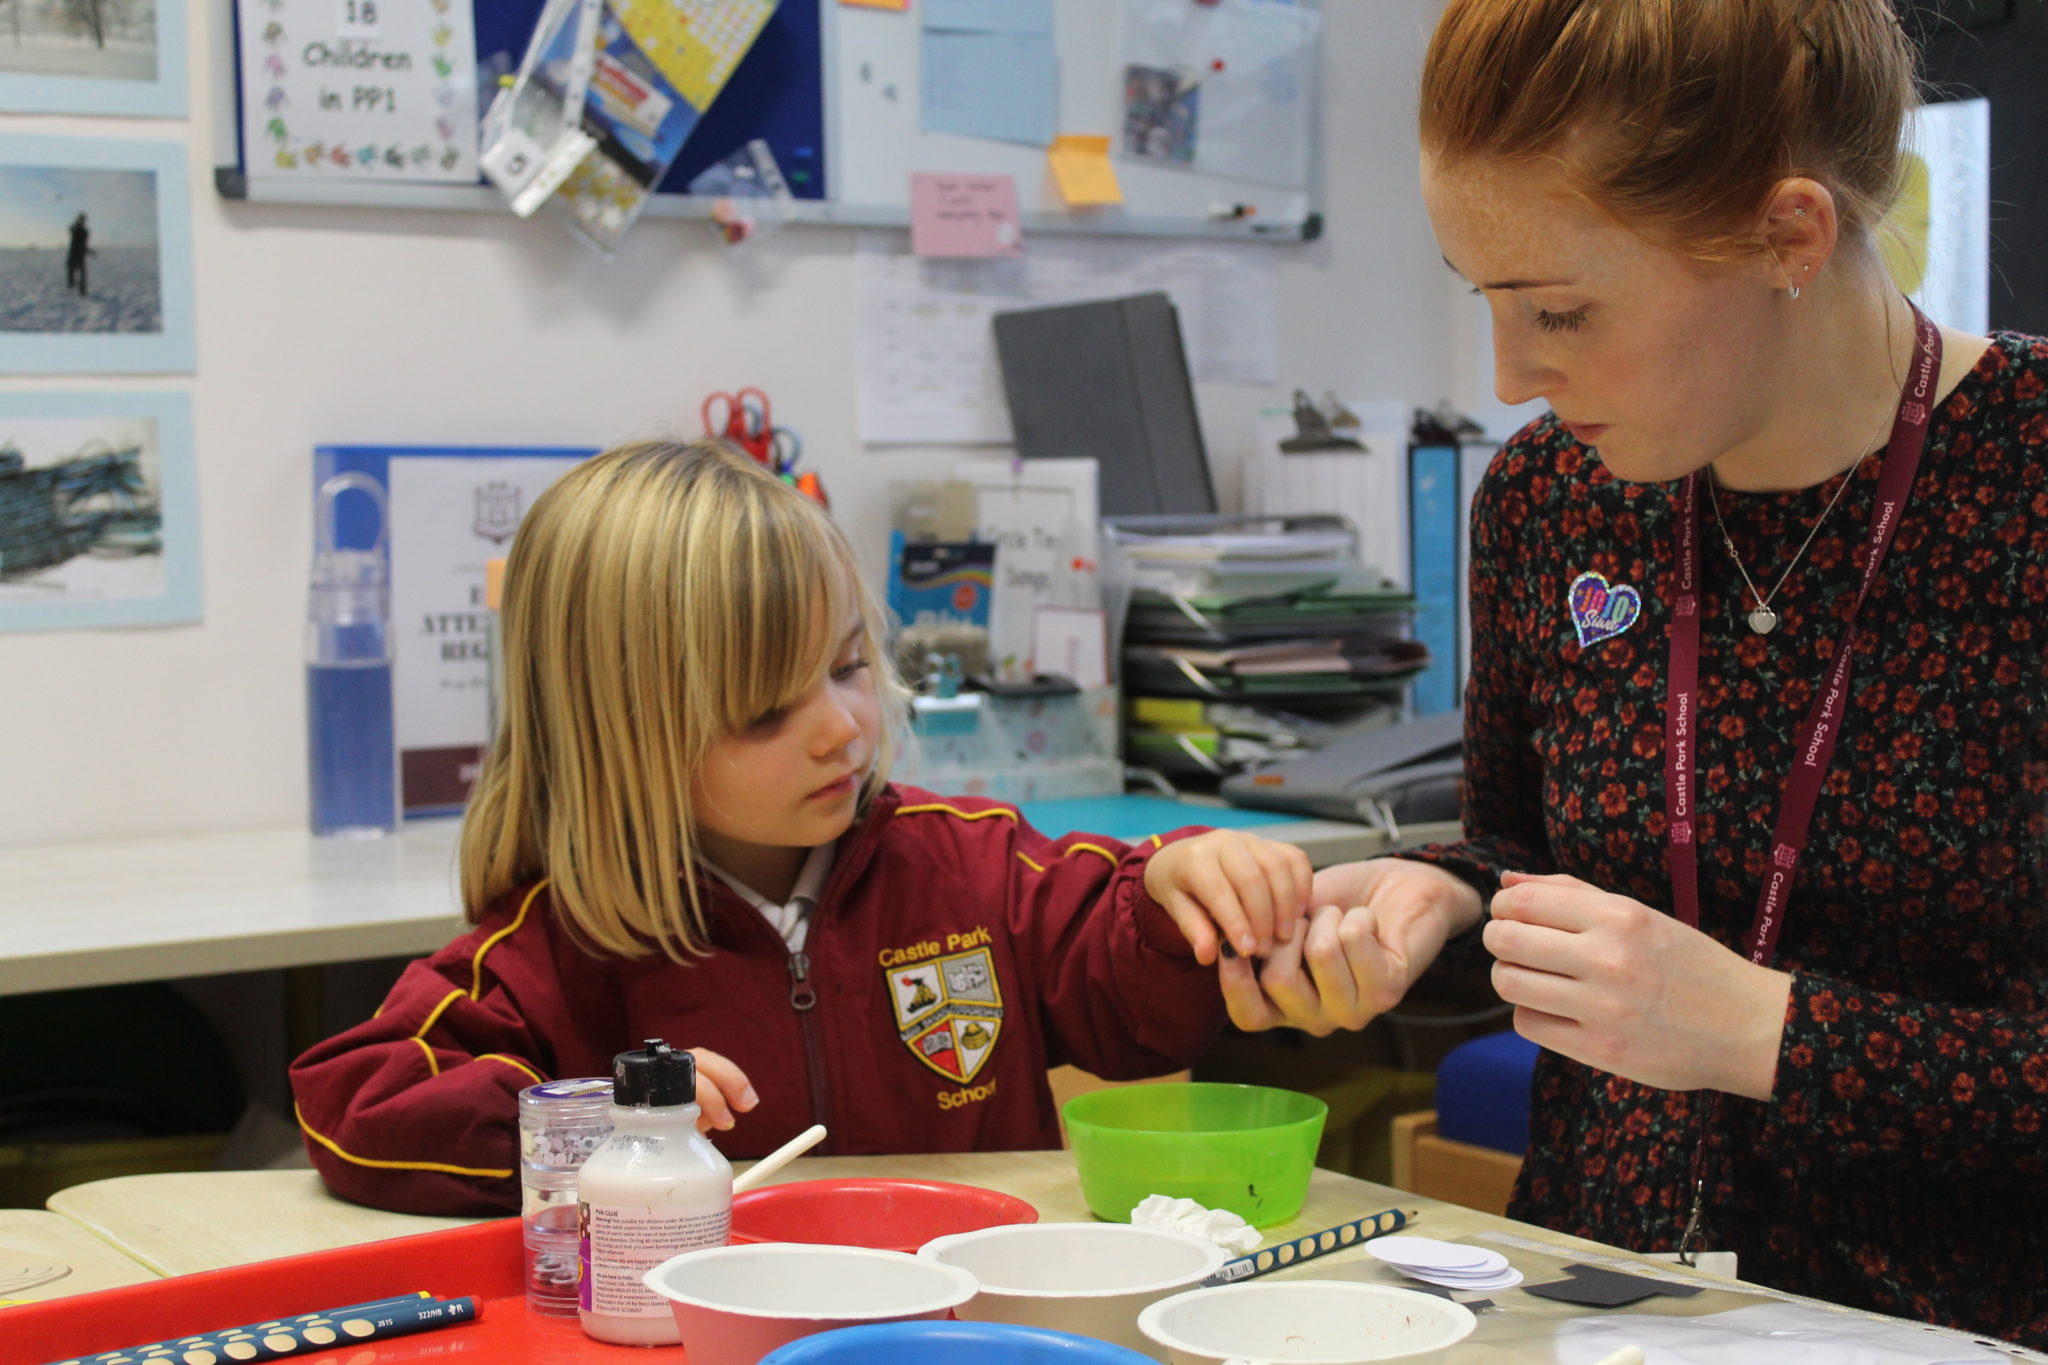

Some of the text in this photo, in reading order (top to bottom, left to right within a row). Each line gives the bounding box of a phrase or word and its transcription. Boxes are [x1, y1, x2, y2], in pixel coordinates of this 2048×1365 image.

[347, 0, 376, 25] 18
[304, 42, 412, 70] Children
[319, 86, 396, 113] in PP1
[1914, 357, 1932, 397] Castle
[1924, 325, 1935, 354] Park
[1683, 518, 1693, 547] Park
[1865, 501, 1895, 578] Park School
[1682, 549, 1692, 590] Castle
[1579, 586, 1630, 623] JOJO
[441, 640, 488, 662] REG
[1804, 645, 1851, 767] Castle Park School
[1676, 692, 1688, 816] Castle Park School
[1765, 872, 1784, 914] Castle
[878, 925, 993, 967] Castle Park
[1756, 916, 1773, 947] Park
[418, 1308, 443, 1320] 322/HB
[456, 1304, 464, 1313] R
